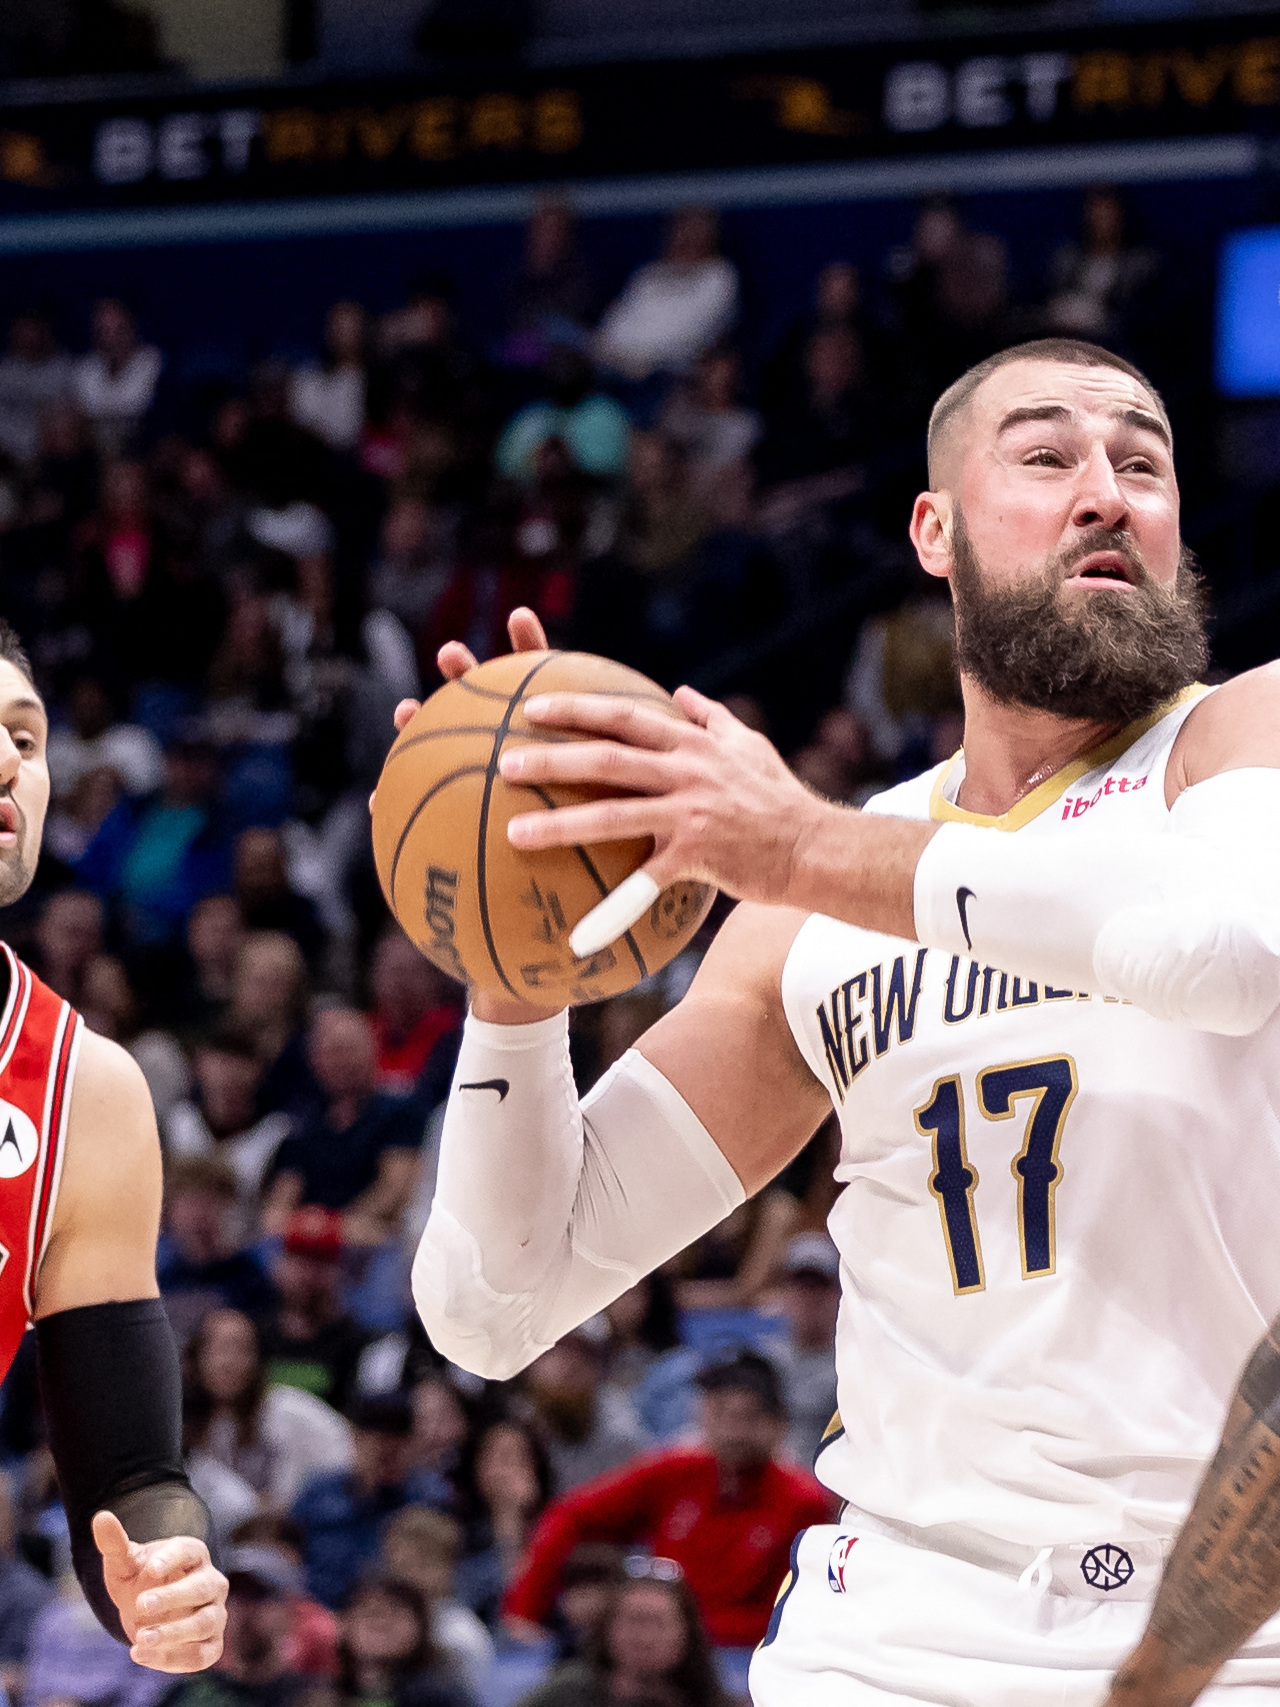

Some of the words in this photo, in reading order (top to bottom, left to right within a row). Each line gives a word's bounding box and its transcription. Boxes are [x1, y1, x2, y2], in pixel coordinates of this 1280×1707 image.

[1061, 774, 1149, 821] ibotta
[816, 947, 929, 1105] NEW
[913, 1052, 1078, 1295] 17
